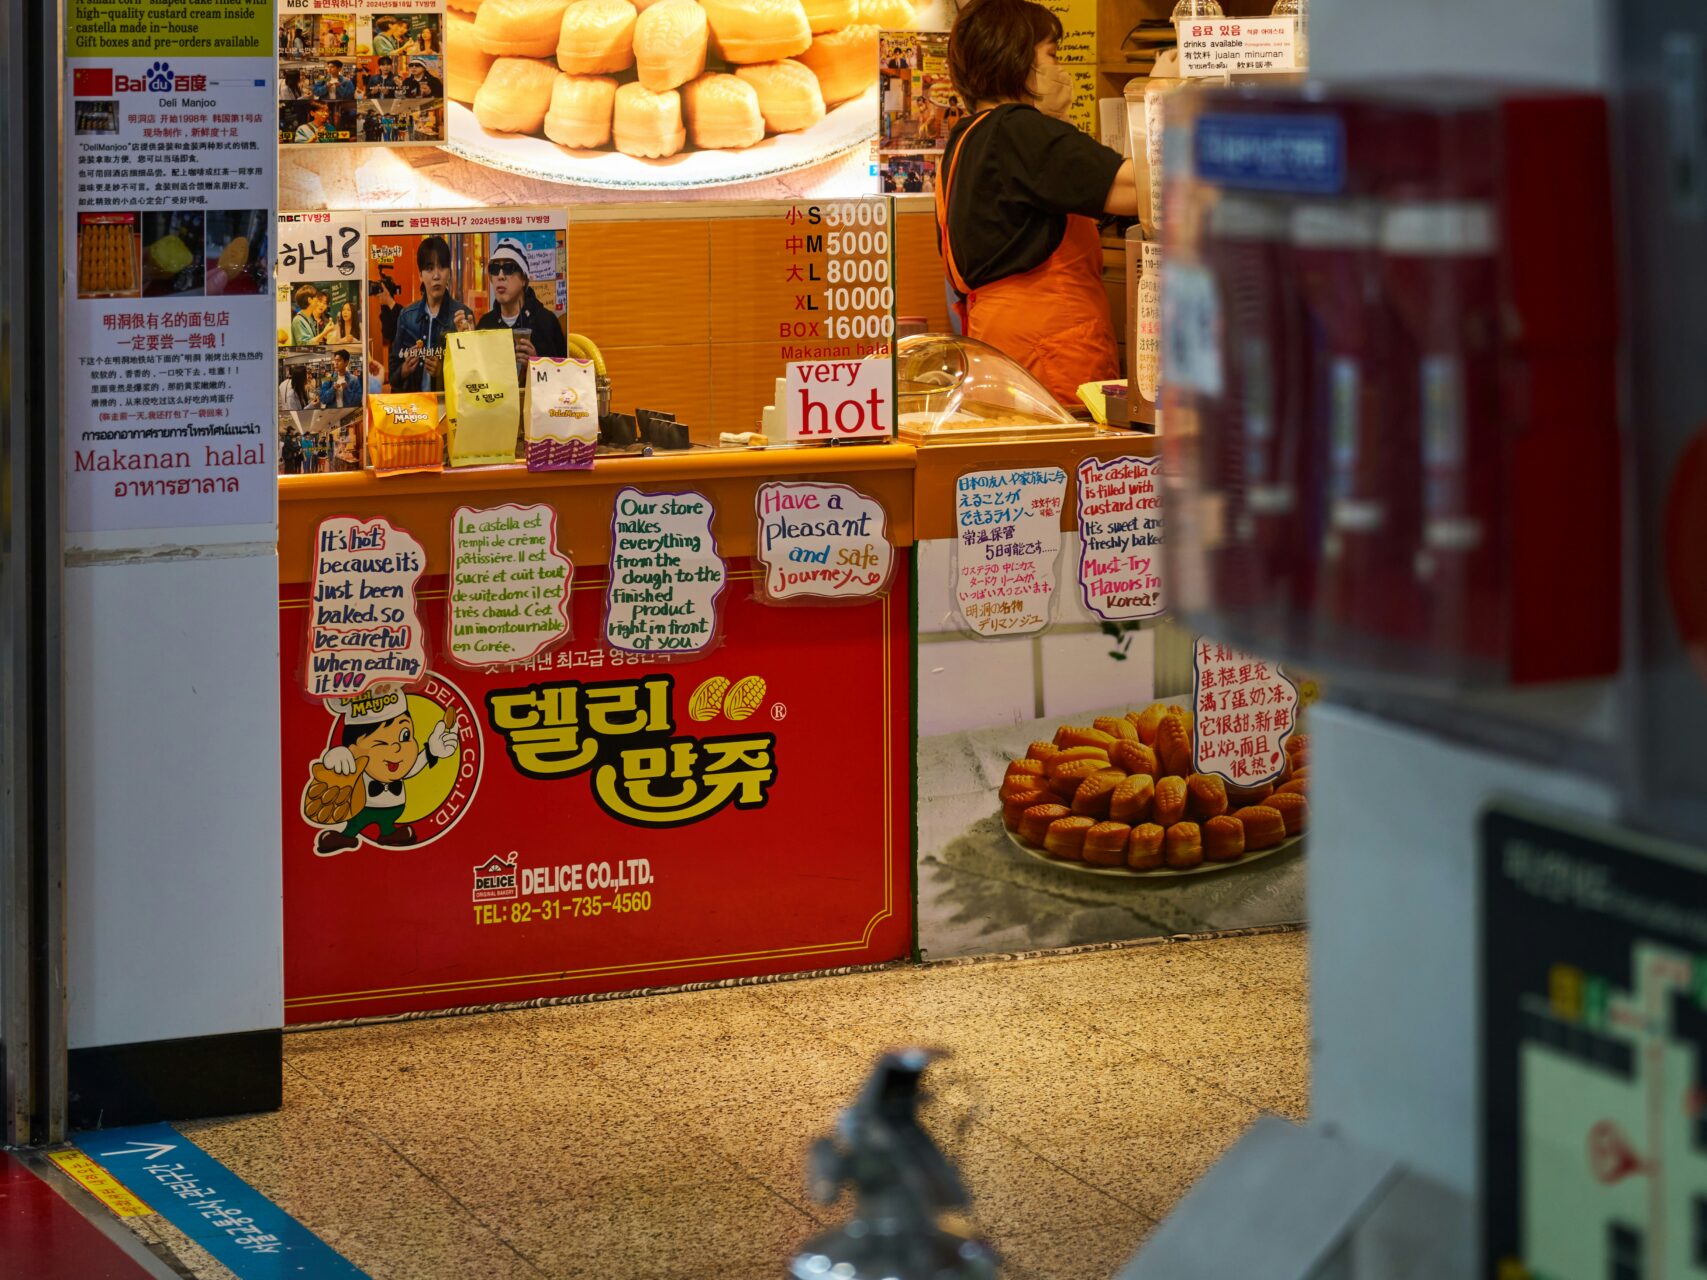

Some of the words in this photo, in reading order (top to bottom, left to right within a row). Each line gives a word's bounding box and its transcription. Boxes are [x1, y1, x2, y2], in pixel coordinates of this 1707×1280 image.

[76, 8, 145, 21] high-quality
[147, 8, 187, 20] custard
[189, 9, 222, 20] cream
[224, 8, 255, 19] inside
[286, 0, 309, 9] MBC
[76, 22, 117, 34] castella
[119, 22, 147, 34] made
[149, 22, 199, 34] in-house
[1191, 25, 1214, 37] 음료
[1219, 24, 1241, 37] 있음
[76, 36, 97, 48] Gift
[99, 36, 129, 48] boxes
[131, 36, 151, 48] and
[154, 36, 212, 50] pre-orders
[214, 36, 260, 48] available
[1183, 39, 1207, 49] drinks
[1210, 38, 1243, 49] available
[159, 98, 177, 108] Deli
[182, 98, 217, 110] Manjoo
[785, 205, 803, 226] 小
[808, 206, 822, 225] S
[826, 202, 888, 227] 3000
[785, 235, 804, 256] 中
[806, 234, 823, 253] M
[826, 231, 889, 256] 5000
[785, 264, 804, 283] 大
[809, 263, 821, 281] L
[826, 259, 889, 283] 8000
[794, 294, 819, 311] XL
[823, 286, 894, 312] 10000
[103, 310, 230, 331] 明洞很有名的面包店
[779, 322, 820, 338] BOX
[823, 315, 895, 340] 16000
[781, 344, 851, 360] Makanan
[856, 341, 894, 356] halal
[797, 362, 862, 387] very
[798, 387, 886, 436] hot
[74, 448, 192, 472] Makanan
[205, 443, 266, 467] halal
[1080, 465, 1104, 485] The
[1104, 463, 1149, 481] castella
[114, 475, 240, 498] อาหารฮาลาล
[1084, 486, 1096, 500] is
[1096, 482, 1126, 499] filled
[1128, 479, 1155, 496] with
[620, 499, 657, 517] Our
[660, 498, 704, 515] store
[764, 490, 820, 514] Have
[827, 494, 844, 510] a
[1083, 496, 1134, 517] custard
[458, 516, 476, 534] Le
[479, 517, 520, 532] castella
[523, 513, 543, 528] est
[616, 519, 662, 534] makes
[766, 512, 872, 551] pleasant
[1084, 520, 1104, 536] It's
[1107, 516, 1140, 533] sweet
[320, 529, 348, 552] It's
[350, 527, 384, 550] hot
[619, 533, 701, 553] everything
[1087, 535, 1131, 553] freshly
[319, 556, 395, 574] because
[395, 550, 420, 572] it's
[614, 554, 653, 570] from
[655, 553, 681, 568] the
[788, 544, 831, 565] and
[836, 543, 880, 570] safe
[1083, 555, 1152, 578] Must-Try
[621, 570, 673, 590] dough
[674, 570, 695, 583] to
[694, 566, 722, 583] the
[1089, 577, 1143, 597] Flavors
[1144, 573, 1162, 589] in
[313, 579, 354, 603] just
[359, 579, 405, 600] been
[611, 586, 674, 604] finished
[1105, 591, 1161, 609] Korea!
[631, 599, 696, 621] product
[314, 629, 339, 649] be
[340, 626, 406, 649] careful
[608, 619, 648, 640] right
[649, 620, 666, 635] in
[667, 617, 710, 635] front
[631, 636, 653, 651] of
[313, 652, 364, 674] when
[364, 651, 422, 676] eating
[557, 648, 605, 670] 최고급
[1200, 662, 1272, 692] 蛋糕里充
[351, 692, 399, 718] MANJOO
[488, 678, 680, 772] 델리
[604, 736, 775, 824] 만쥬
[476, 875, 515, 890] DELICE
[521, 864, 583, 896] DELICE
[473, 904, 508, 925] TEL:
[510, 890, 652, 923] 82-31-735-4560
